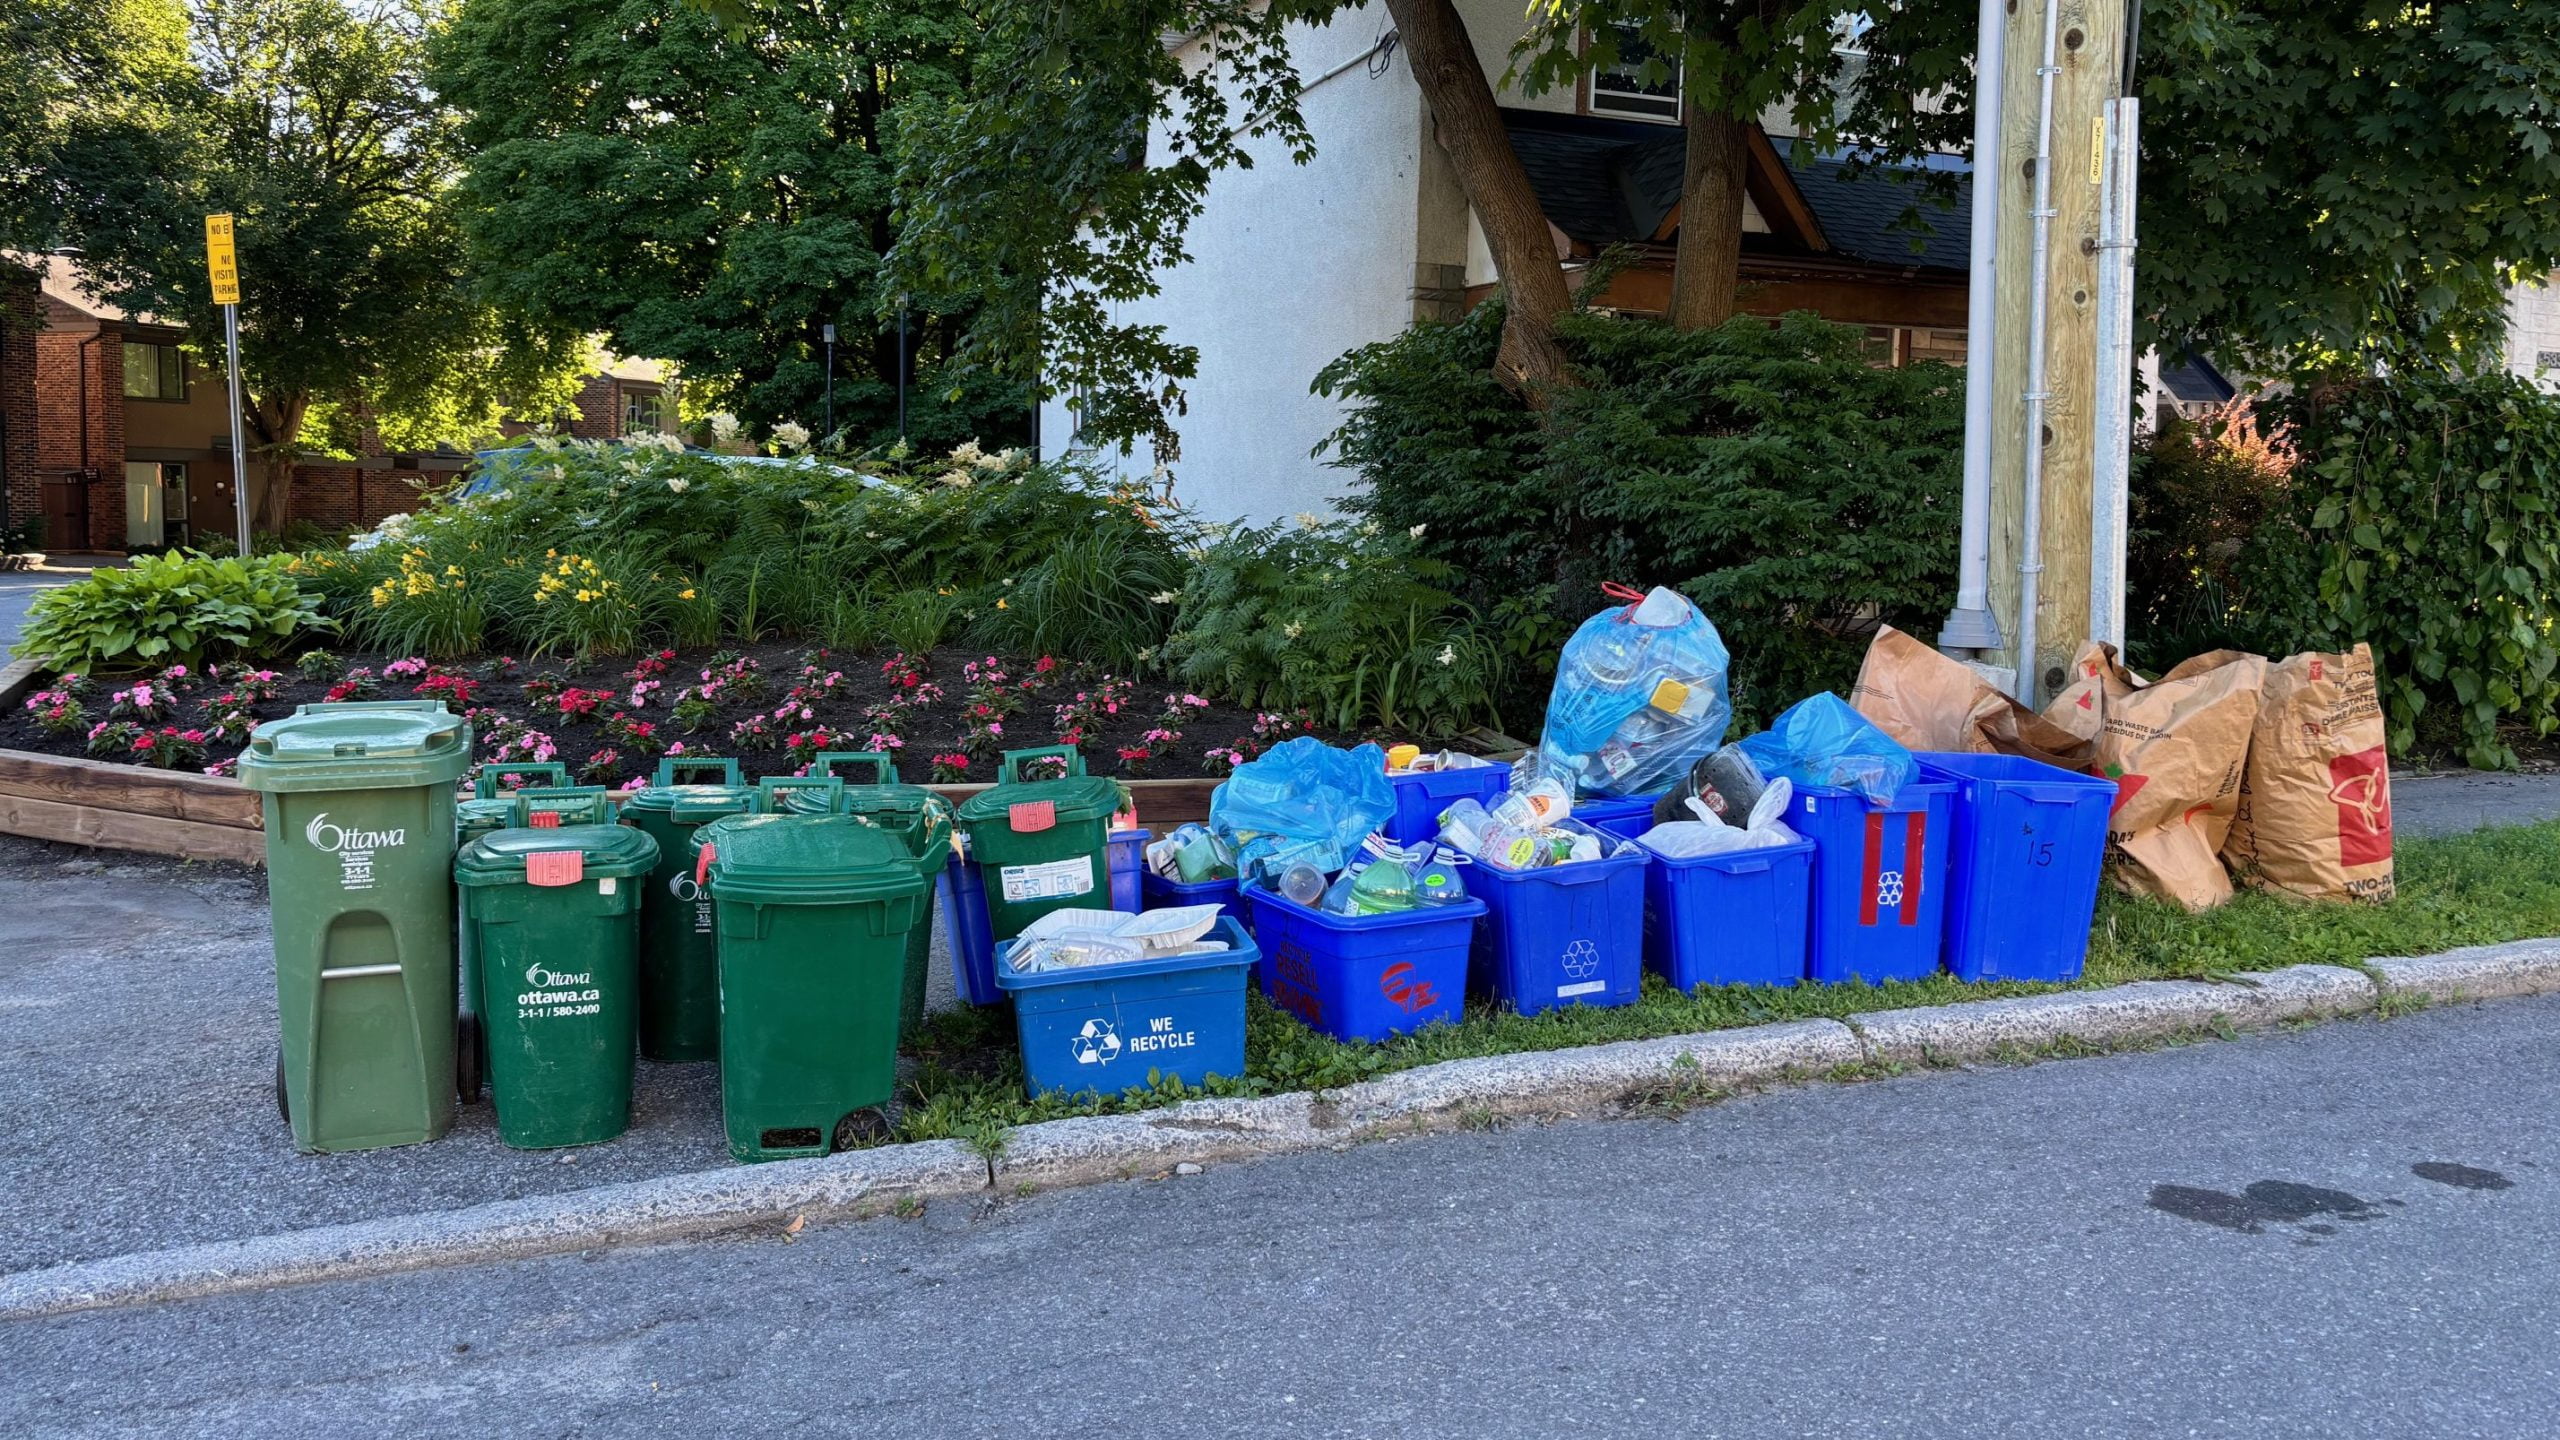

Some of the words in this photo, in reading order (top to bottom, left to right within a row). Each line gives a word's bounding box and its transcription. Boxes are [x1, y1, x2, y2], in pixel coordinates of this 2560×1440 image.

[211, 224, 221, 235] NO
[2125, 720, 2149, 733] WASTE
[2135, 732, 2146, 741] DE
[312, 818, 405, 852] Ottawa
[2027, 840, 2055, 867] 15
[345, 866, 370, 875] 3-1-1
[529, 966, 590, 987] Ottawa
[518, 989, 600, 1005] ottawa.ca
[518, 1007, 544, 1018] 3-1-1
[553, 1004, 600, 1017] 580-2400
[1149, 1016, 1173, 1032] WE
[1130, 1031, 1196, 1052] RECYCLE
